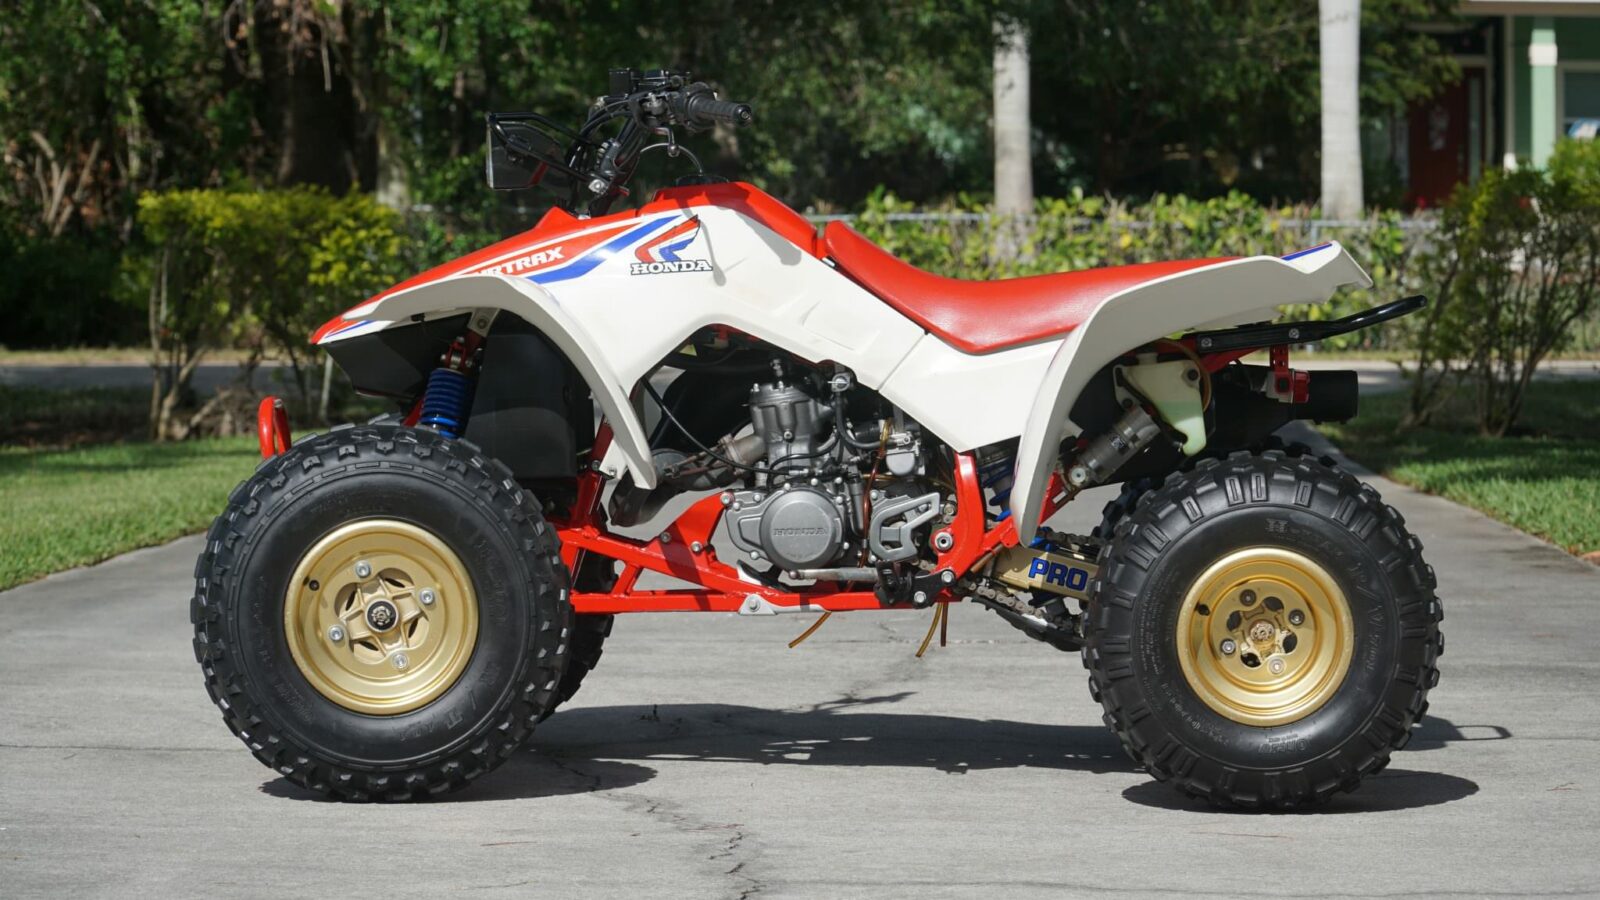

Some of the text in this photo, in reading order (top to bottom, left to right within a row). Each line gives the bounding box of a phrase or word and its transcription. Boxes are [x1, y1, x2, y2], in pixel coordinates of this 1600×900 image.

[630, 259, 714, 276] HONDA
[773, 527, 828, 537] HONDA
[1028, 557, 1088, 591] PRO
